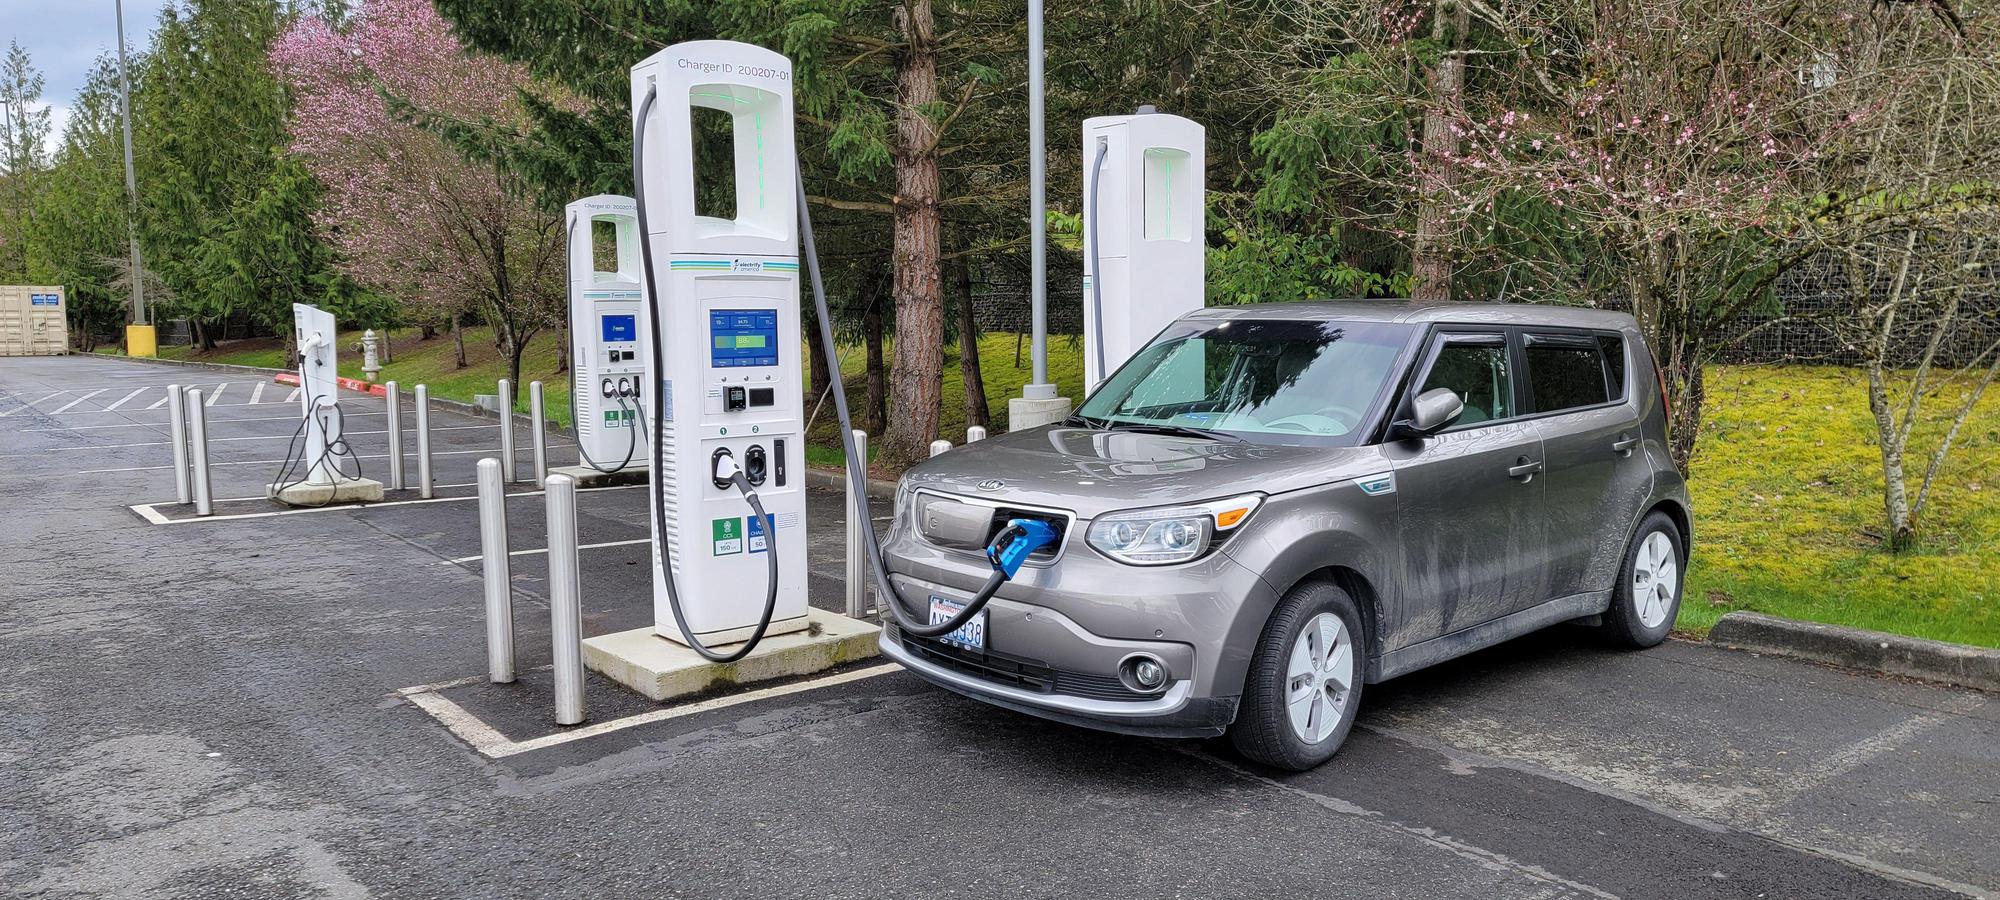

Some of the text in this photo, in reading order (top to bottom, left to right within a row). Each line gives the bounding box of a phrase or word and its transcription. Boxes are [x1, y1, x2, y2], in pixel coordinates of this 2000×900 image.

[677, 58, 790, 81] Charger ID 200207-01
